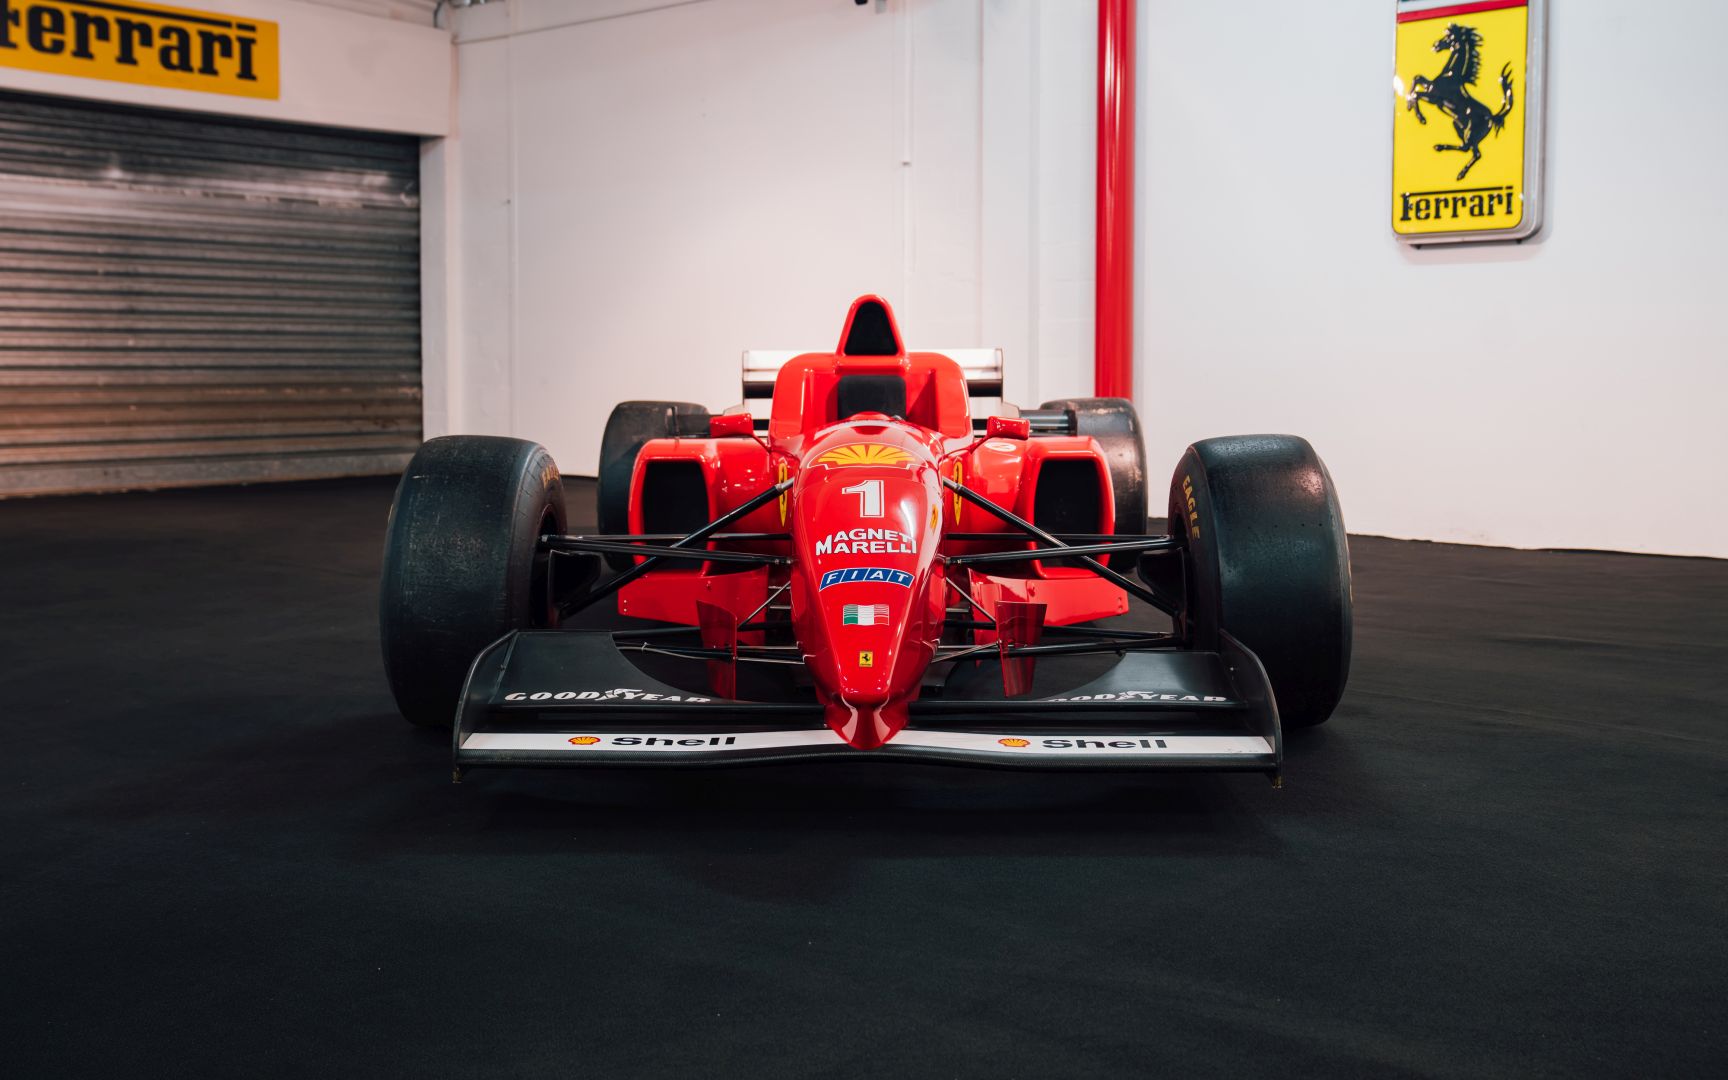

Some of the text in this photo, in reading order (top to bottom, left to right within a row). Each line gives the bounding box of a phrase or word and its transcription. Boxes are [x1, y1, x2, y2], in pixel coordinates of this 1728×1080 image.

[1400, 186, 1513, 221] Ferrari
[841, 480, 885, 518] 1
[1182, 474, 1201, 539] EAGLE
[816, 538, 917, 556] MARELLI
[825, 569, 910, 586] FIAT
[504, 690, 711, 703] GOODYEAR
[1047, 692, 1228, 702] ODYEAR
[611, 736, 736, 747] Shell
[1042, 738, 1168, 749] Shell
